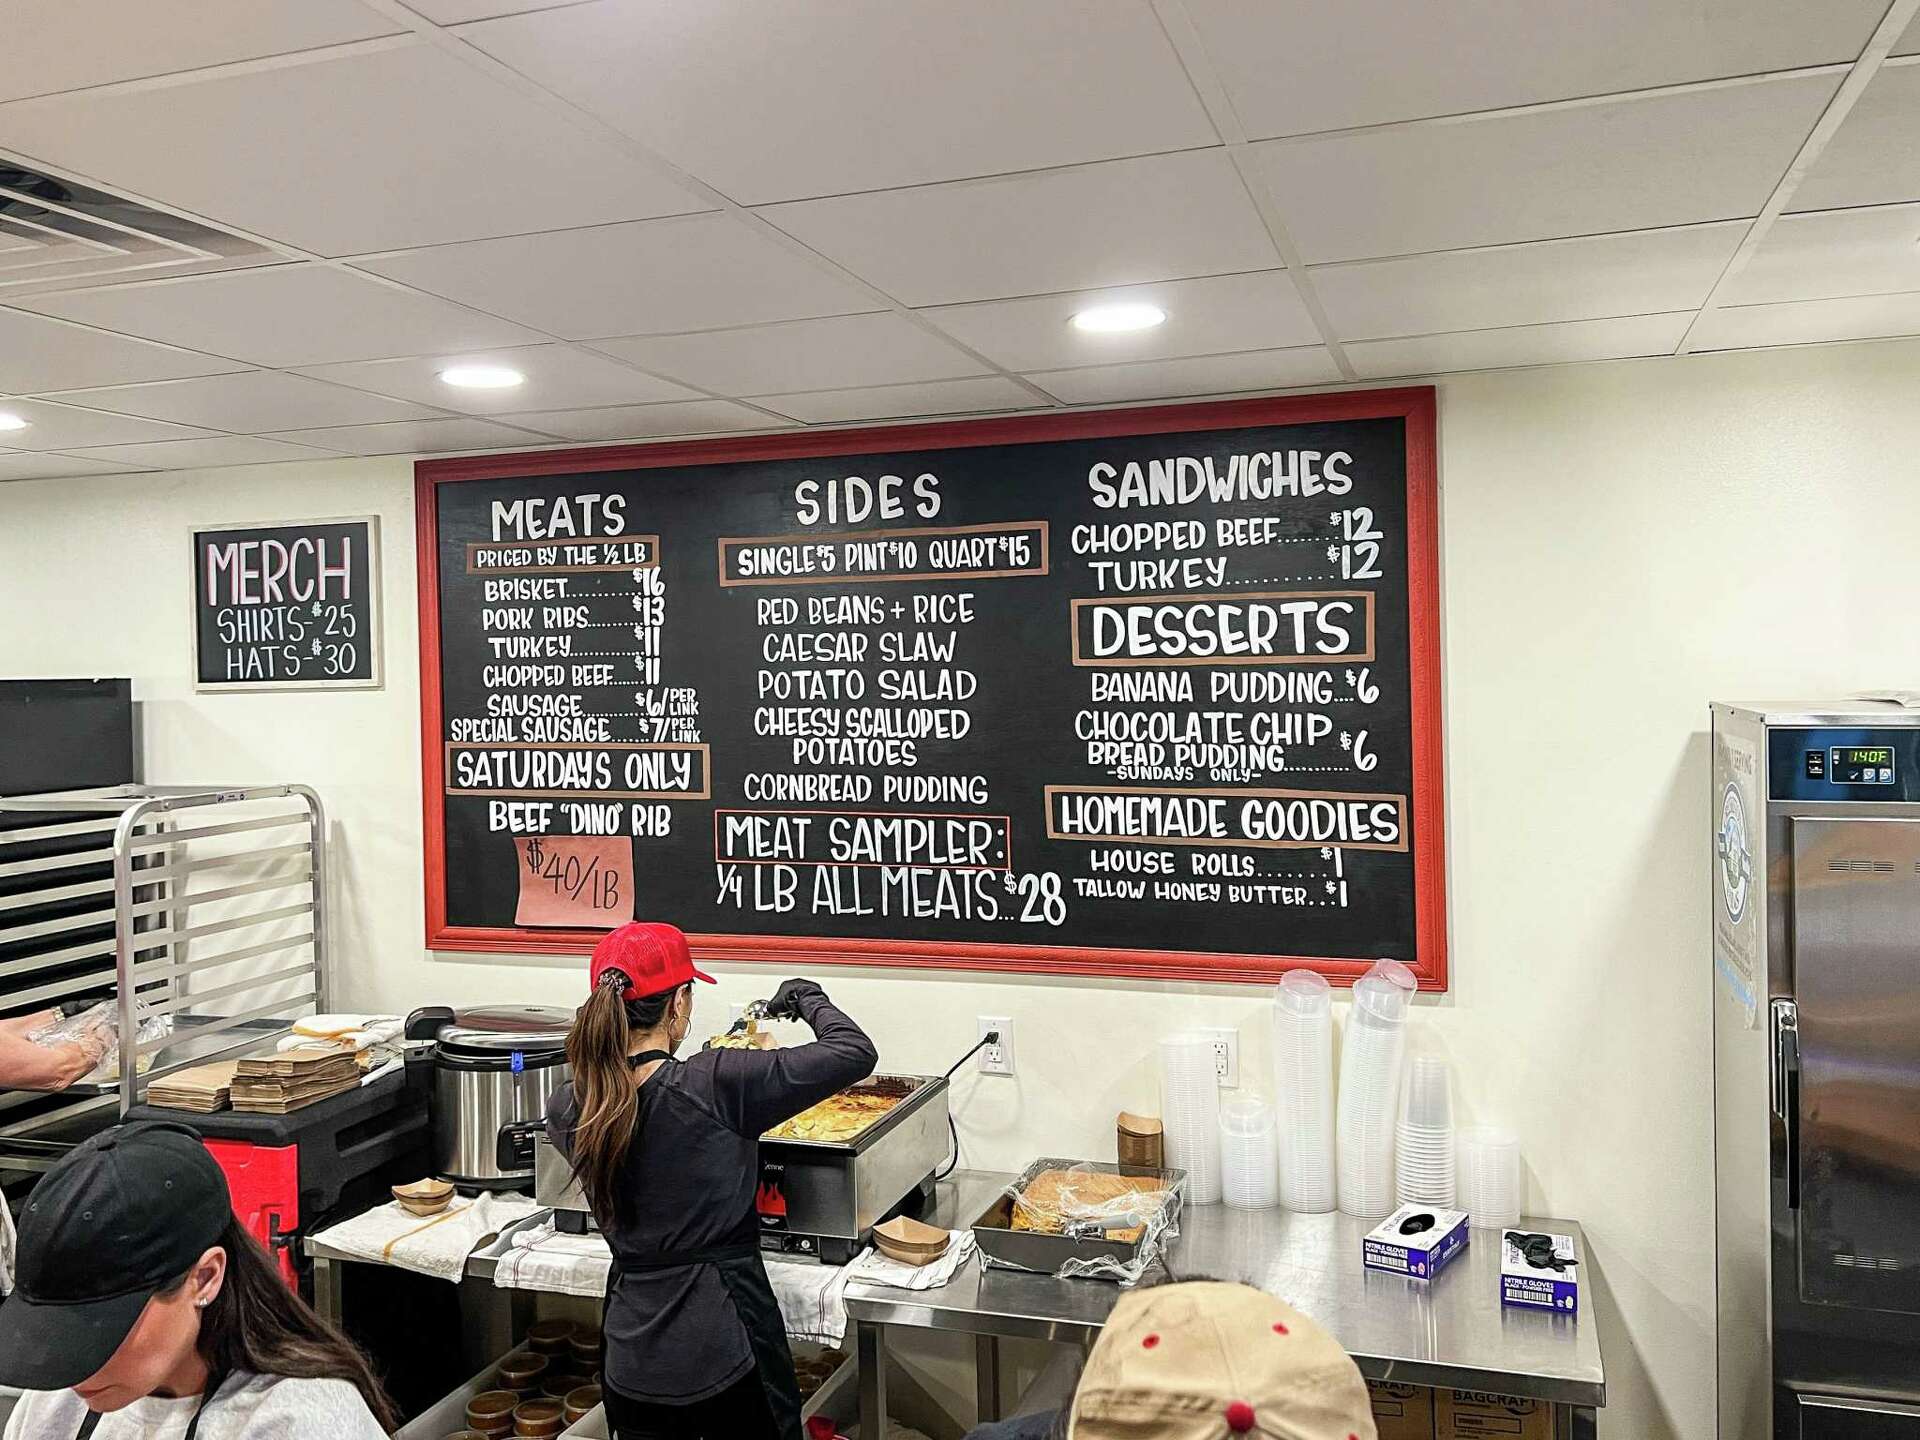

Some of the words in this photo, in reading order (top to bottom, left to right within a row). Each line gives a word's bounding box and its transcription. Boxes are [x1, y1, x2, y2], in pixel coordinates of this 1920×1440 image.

[1089, 451, 1352, 507] SANDWICHES
[796, 474, 940, 525] SIDES
[492, 494, 625, 542] MEATS
[1072, 521, 1206, 554] CHOPPED
[1217, 518, 1280, 547] BEEF
[478, 550, 531, 567] PRICED
[537, 547, 557, 565] BY
[564, 546, 596, 565] THE
[624, 543, 645, 563] LB
[207, 537, 351, 606] MERCH
[1089, 557, 1227, 591] TURKEY
[485, 578, 568, 601] BRISKET
[483, 608, 533, 630] PORK
[543, 606, 590, 628] RIBS
[758, 598, 798, 625] RED
[808, 596, 884, 624] BEANS
[914, 594, 974, 623] RICE
[1094, 602, 1355, 658] DESSERTS
[488, 635, 571, 658] TURKEY
[764, 632, 867, 662] CAESAR
[880, 631, 956, 662] SLAW
[484, 665, 564, 687] CHOPPED
[572, 665, 614, 686] BEEF
[759, 669, 864, 699] POTATO
[878, 669, 976, 700] SALAD
[1092, 671, 1193, 702] BANANA
[1211, 671, 1332, 704] PUDDING
[487, 694, 583, 717] SAUSAGE
[670, 688, 695, 702] PER
[670, 700, 698, 715] LINK
[451, 718, 518, 742] SPECIAL
[522, 717, 612, 743] SAUSAGE
[672, 717, 694, 730] PER
[672, 730, 700, 742] LINK
[755, 707, 840, 736] CHEESY
[846, 707, 970, 739] SCALLOPED
[1075, 711, 1244, 744] CHOCOLATE
[1251, 712, 1332, 747] CHIP
[794, 738, 917, 766] POTATOES
[1087, 741, 1165, 766] BREAD
[1174, 744, 1285, 772] PUDDING
[1853, 751, 1887, 763] 140F
[458, 750, 611, 789] SATURDAYS
[625, 752, 690, 790] ONLY
[744, 774, 871, 801] CORNBREAD
[884, 775, 988, 804] PUDDING
[490, 801, 553, 832] BEEF
[632, 804, 671, 836] RIB
[1061, 795, 1228, 838] HOMEMADE
[1239, 800, 1398, 842] GOODIES
[726, 816, 811, 858] MEAT
[1091, 850, 1174, 873] HOUSE
[1192, 854, 1254, 876] ROLLS
[755, 865, 797, 912] LB
[813, 865, 875, 915] ALL
[882, 866, 1000, 920] MEATS
[1073, 879, 1145, 898] TALLOW
[1155, 882, 1220, 901] HONEY
[1229, 885, 1306, 905] BUTTER
[1386, 1245, 1408, 1255] GLOVES
[1504, 1277, 1528, 1286] NITRILE
[1528, 1280, 1554, 1289] GLOVES
